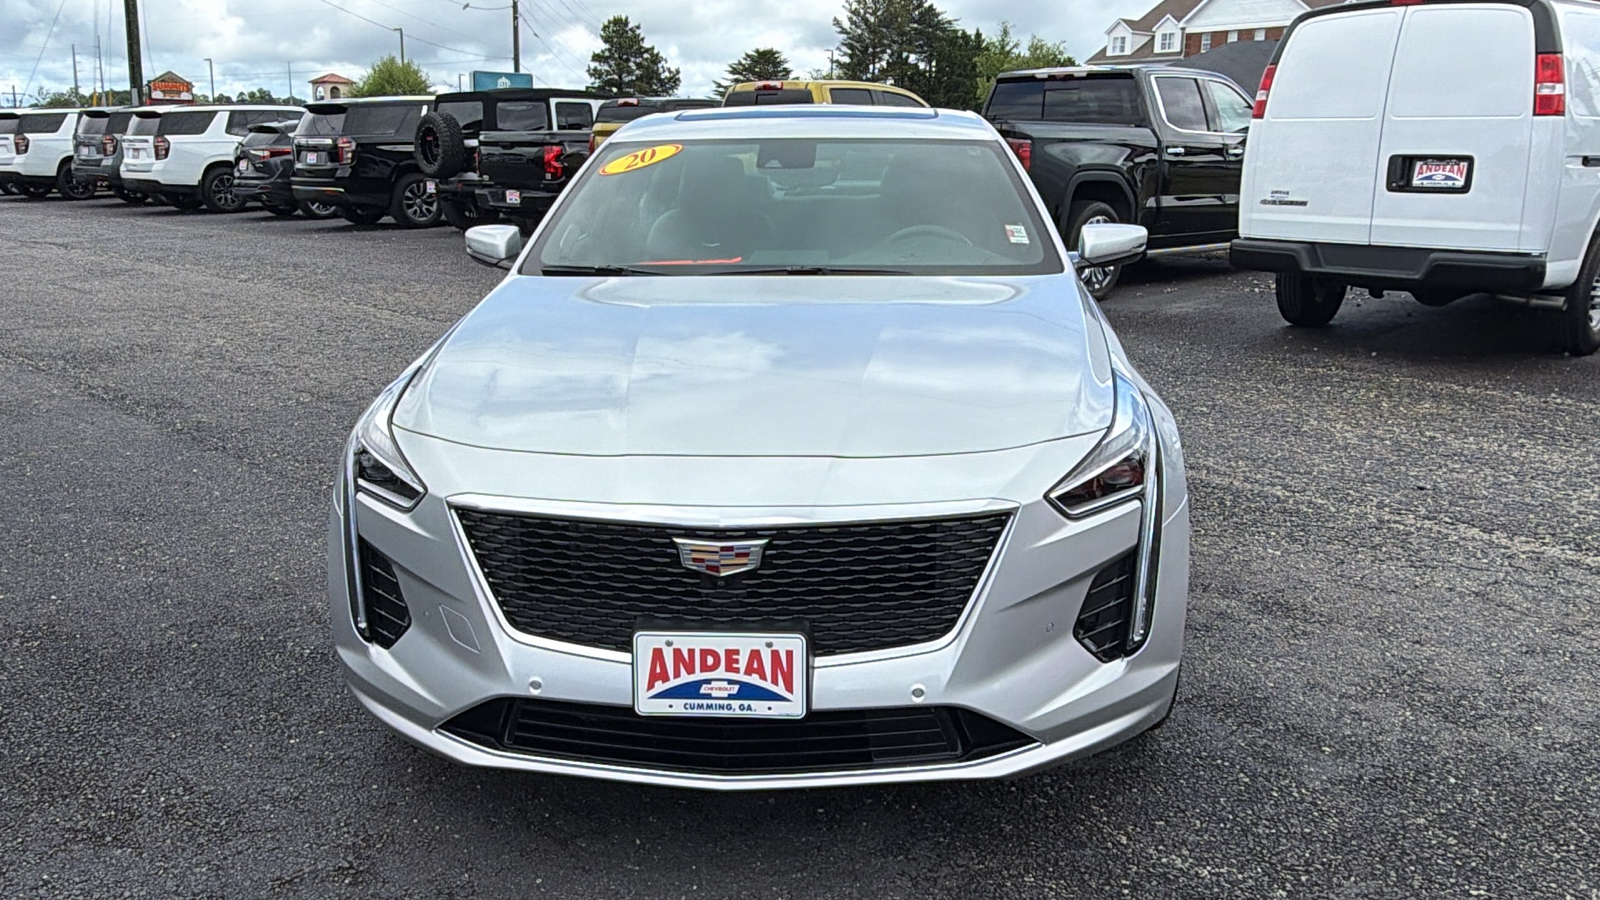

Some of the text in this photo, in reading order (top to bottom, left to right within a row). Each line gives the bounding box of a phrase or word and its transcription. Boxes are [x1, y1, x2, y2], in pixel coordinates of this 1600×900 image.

[624, 148, 656, 170] 20
[1416, 164, 1465, 179] ANDEAN
[646, 647, 794, 696] ANDEAN
[683, 702, 757, 712] CUMMING, GA.
